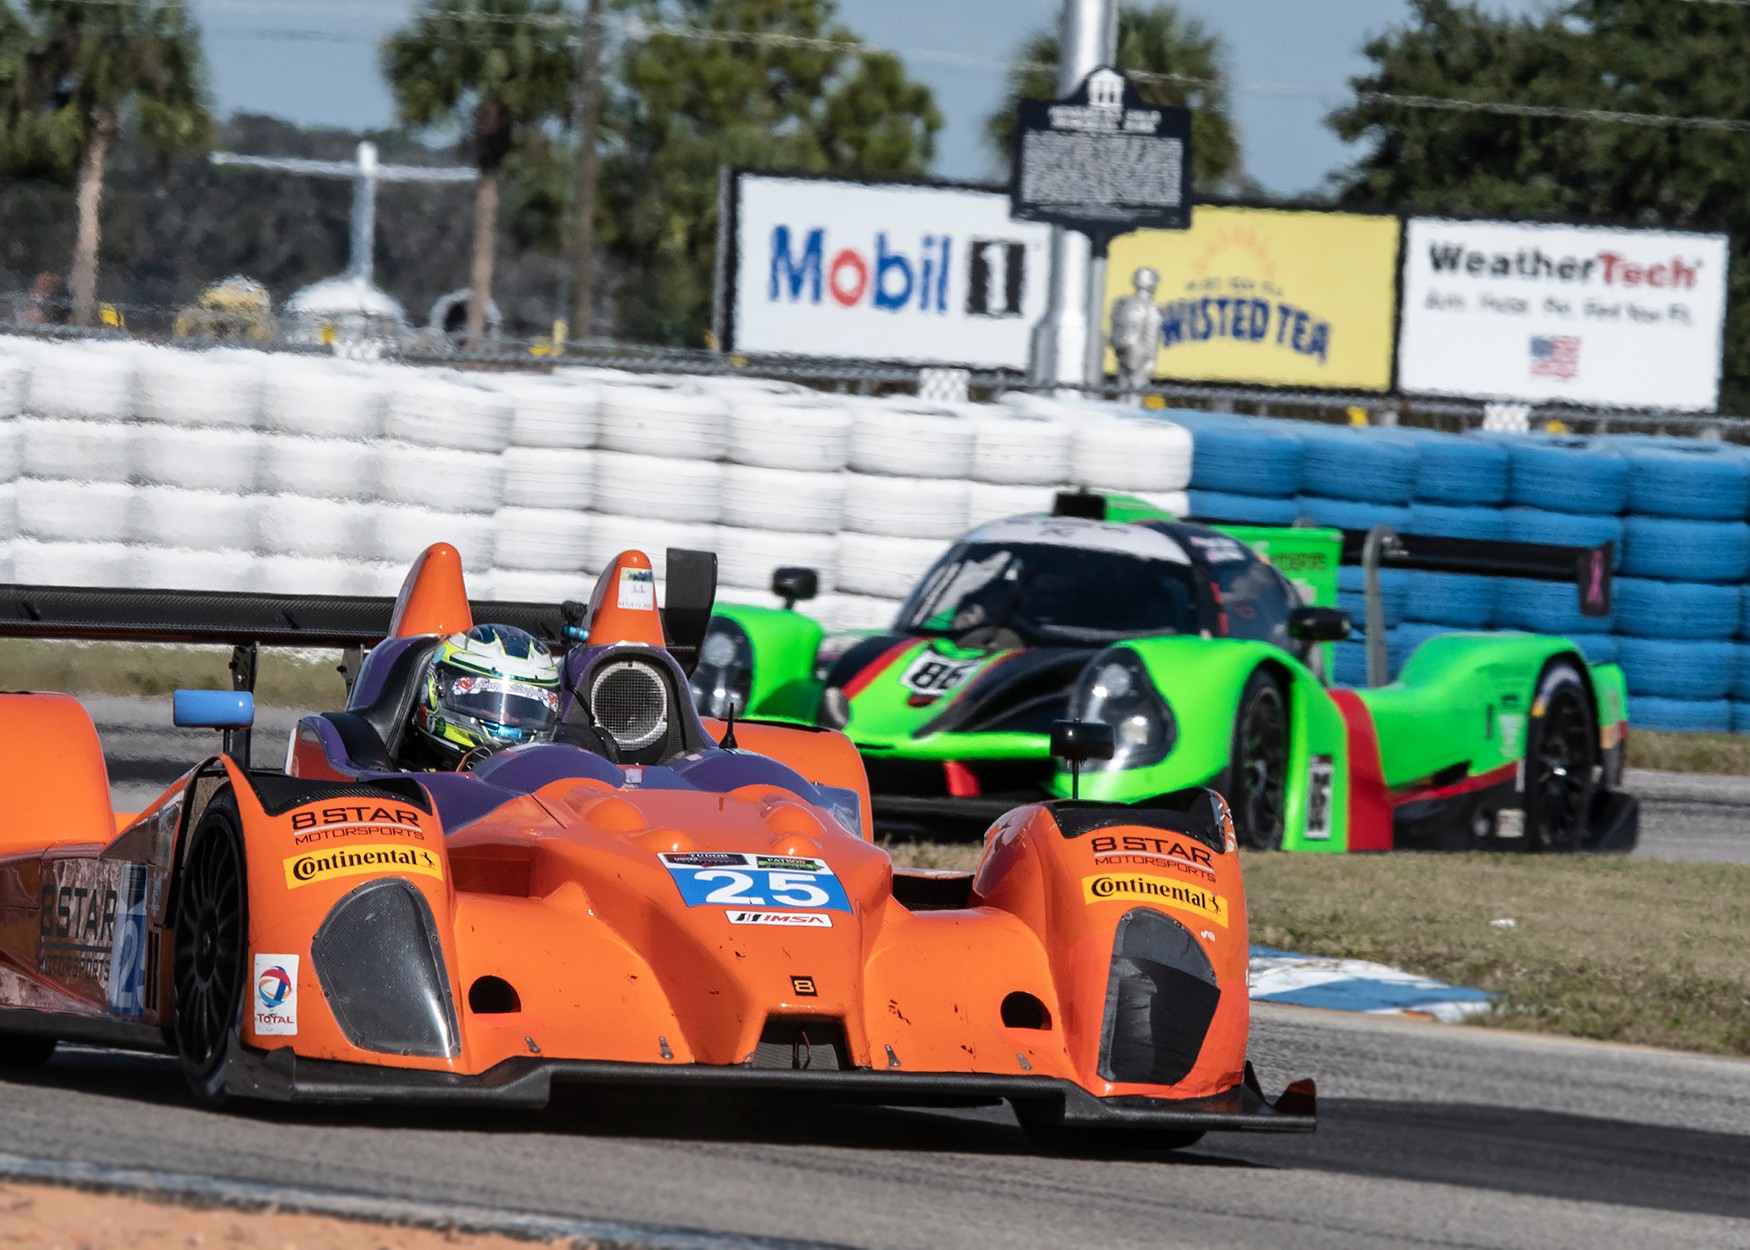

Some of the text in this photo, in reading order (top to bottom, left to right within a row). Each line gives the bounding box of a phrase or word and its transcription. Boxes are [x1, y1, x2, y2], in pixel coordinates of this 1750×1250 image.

[768, 224, 1020, 317] Mobil 1
[1427, 243, 1698, 289] WeatherTech
[1160, 297, 1331, 365] WISTED TEA
[911, 661, 968, 690] 86
[291, 806, 421, 831] 8 STAR
[294, 826, 426, 846] MOTORSPORTS
[292, 850, 418, 881] Continental
[1091, 836, 1215, 869] 8 STAR
[1094, 854, 1217, 883] MOTORSPORTS
[693, 869, 830, 907] 25
[1090, 876, 1207, 910] Continental
[763, 914, 825, 924] IMSA
[794, 979, 815, 993] 8
[256, 1013, 295, 1024] TOTAL
